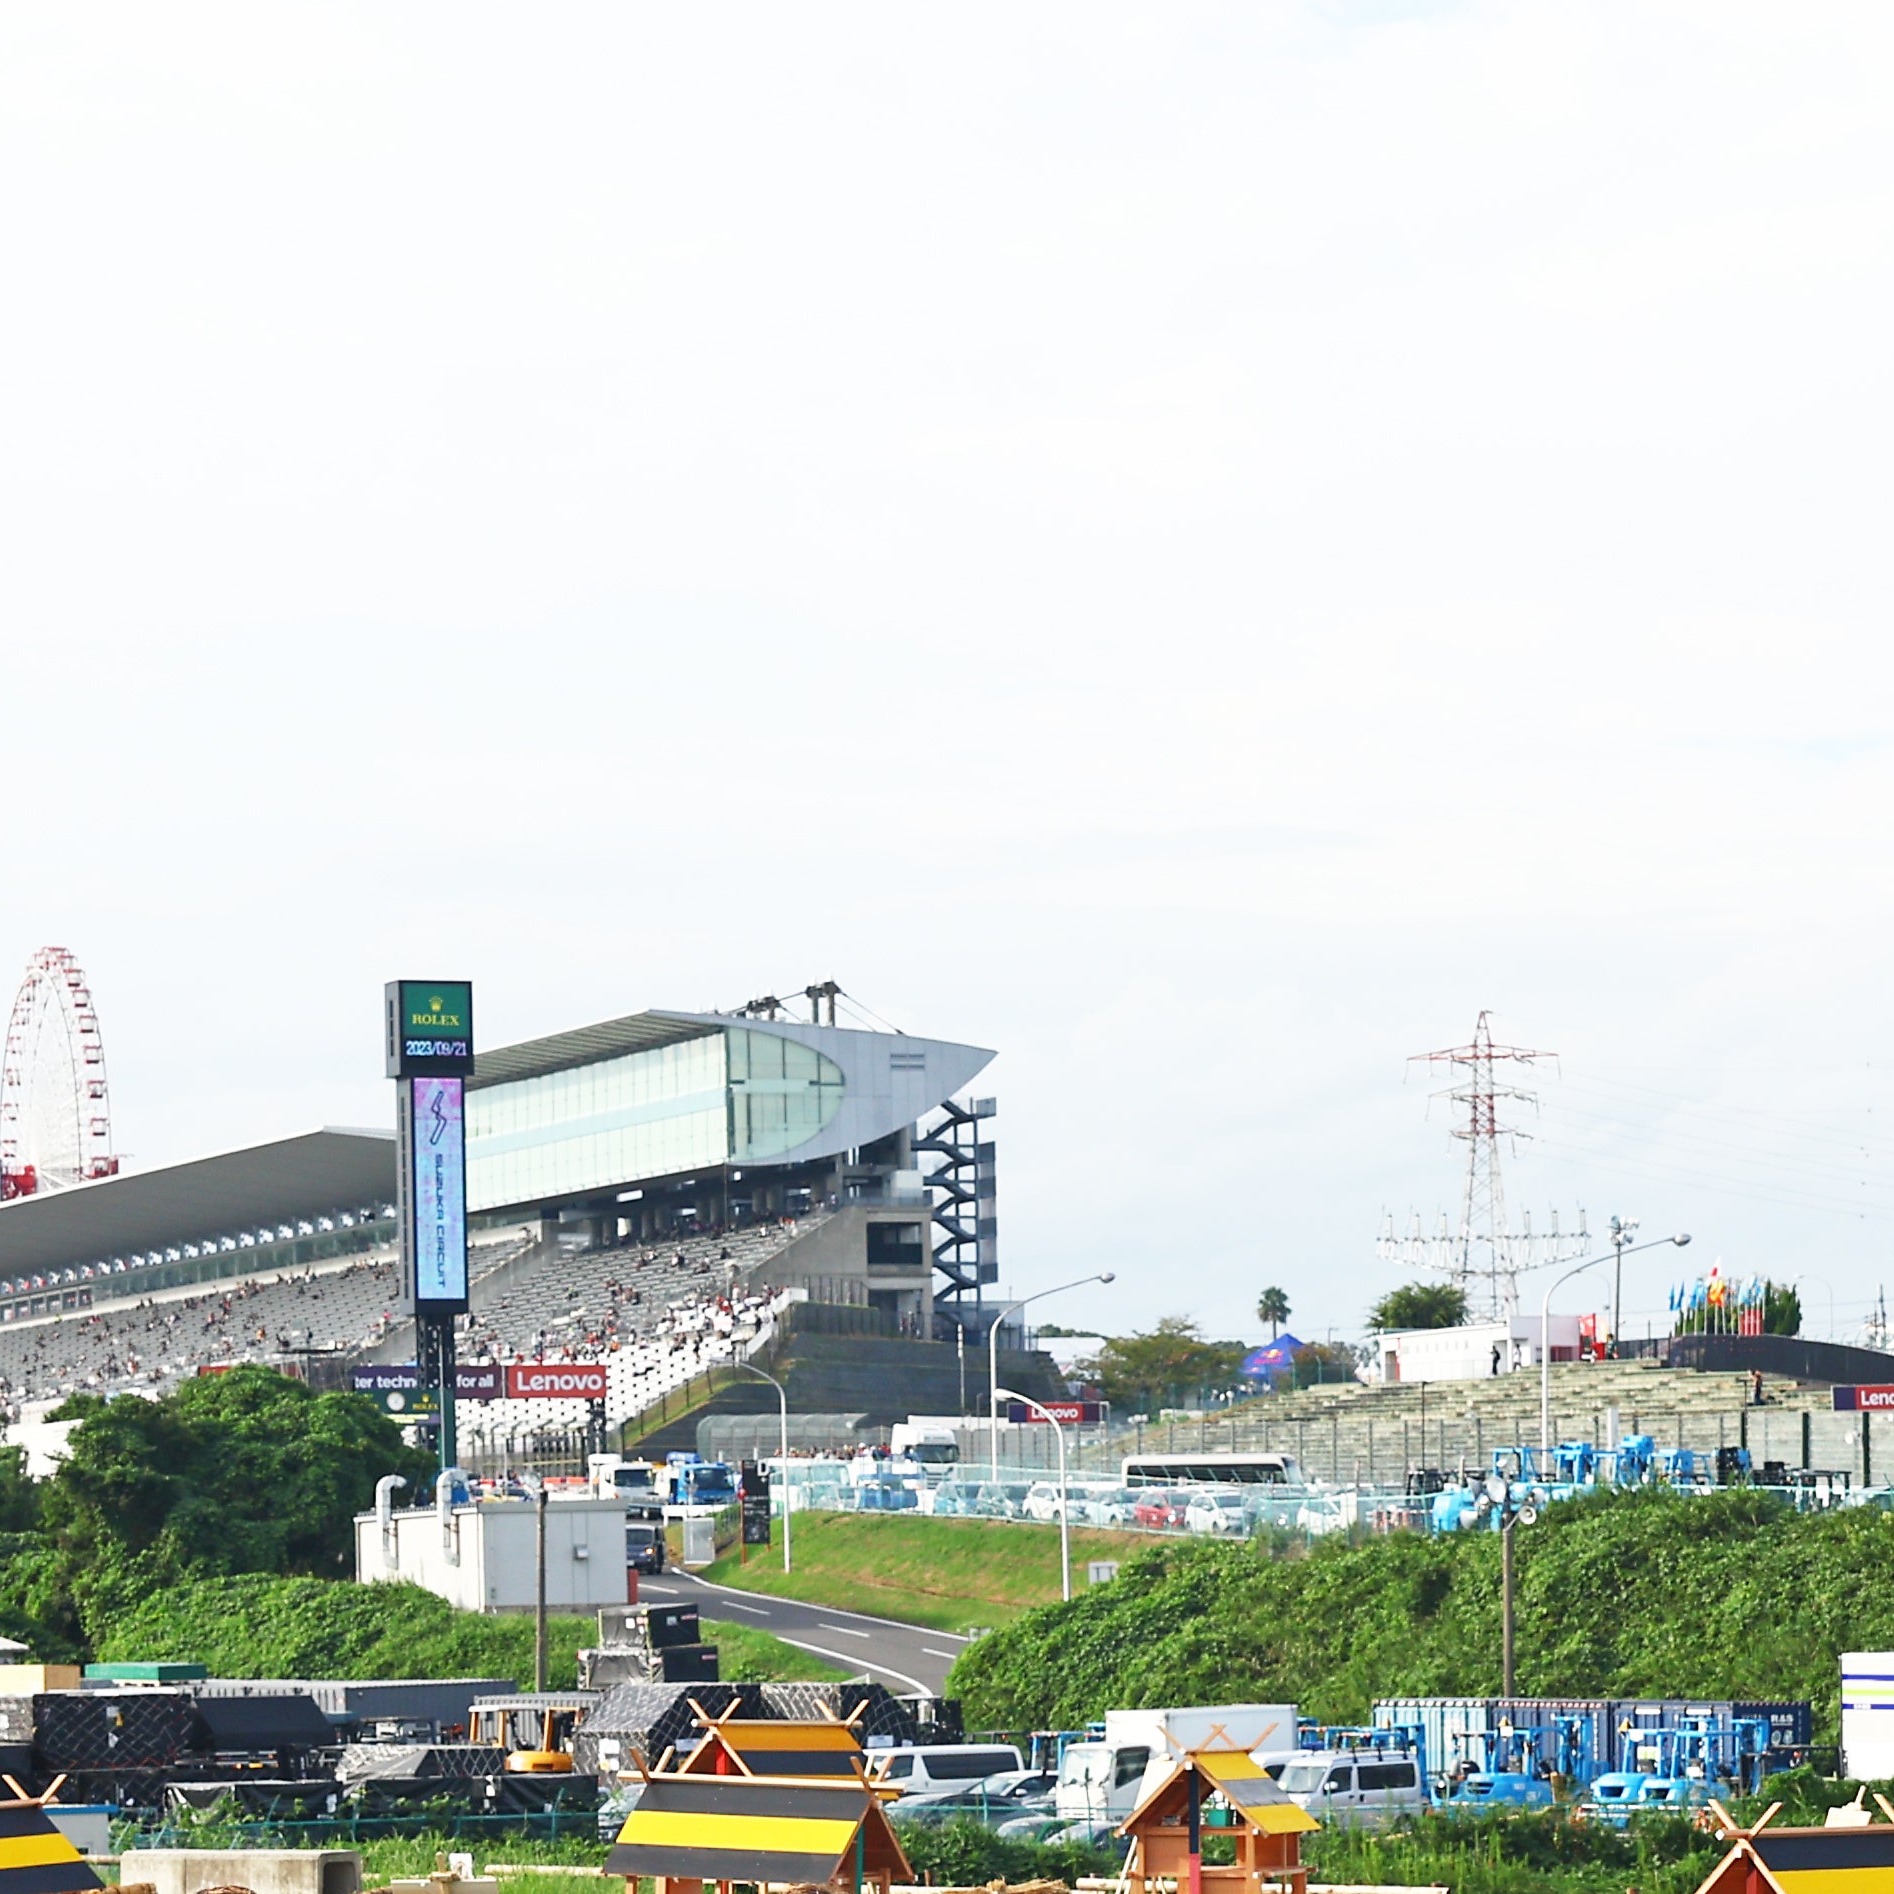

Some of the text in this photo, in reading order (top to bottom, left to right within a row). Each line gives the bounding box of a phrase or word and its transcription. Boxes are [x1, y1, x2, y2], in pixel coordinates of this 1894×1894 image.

[412, 1013, 460, 1026] ROLEX
[435, 1153, 446, 1288] SUZUKA CIRCUIT
[456, 1374, 475, 1388] for
[478, 1374, 494, 1388] all
[517, 1371, 603, 1391] Lenovo
